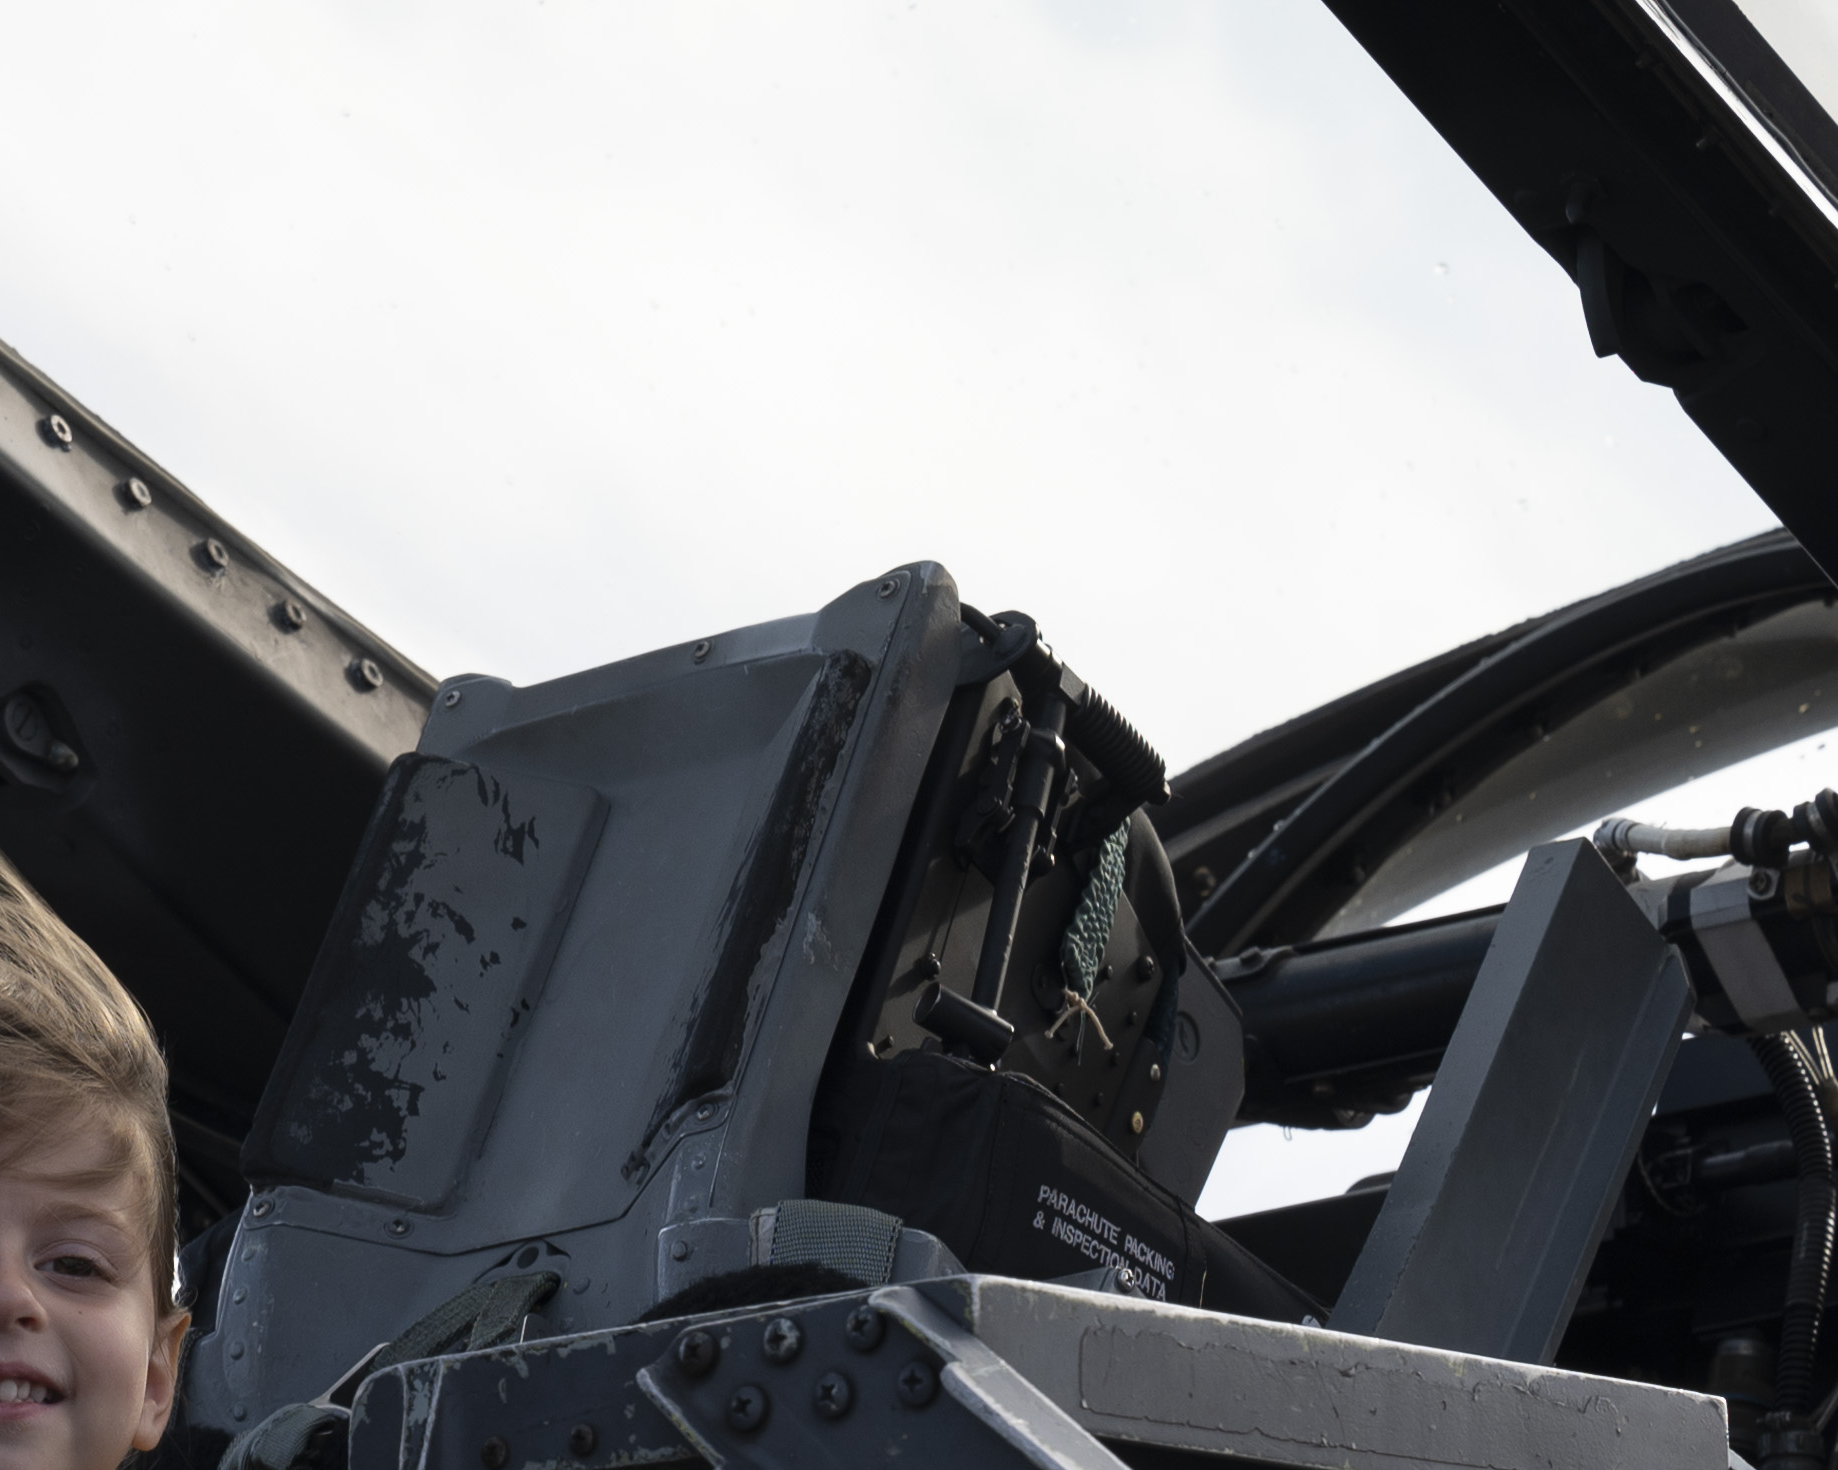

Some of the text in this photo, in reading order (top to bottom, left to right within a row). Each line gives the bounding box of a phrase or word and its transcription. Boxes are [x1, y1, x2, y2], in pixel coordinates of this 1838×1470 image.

[1033, 1211, 1045, 1230] &
[1133, 1266, 1166, 1302] DATA
[1037, 1185, 1175, 1280] PARACHUTE PACKING
